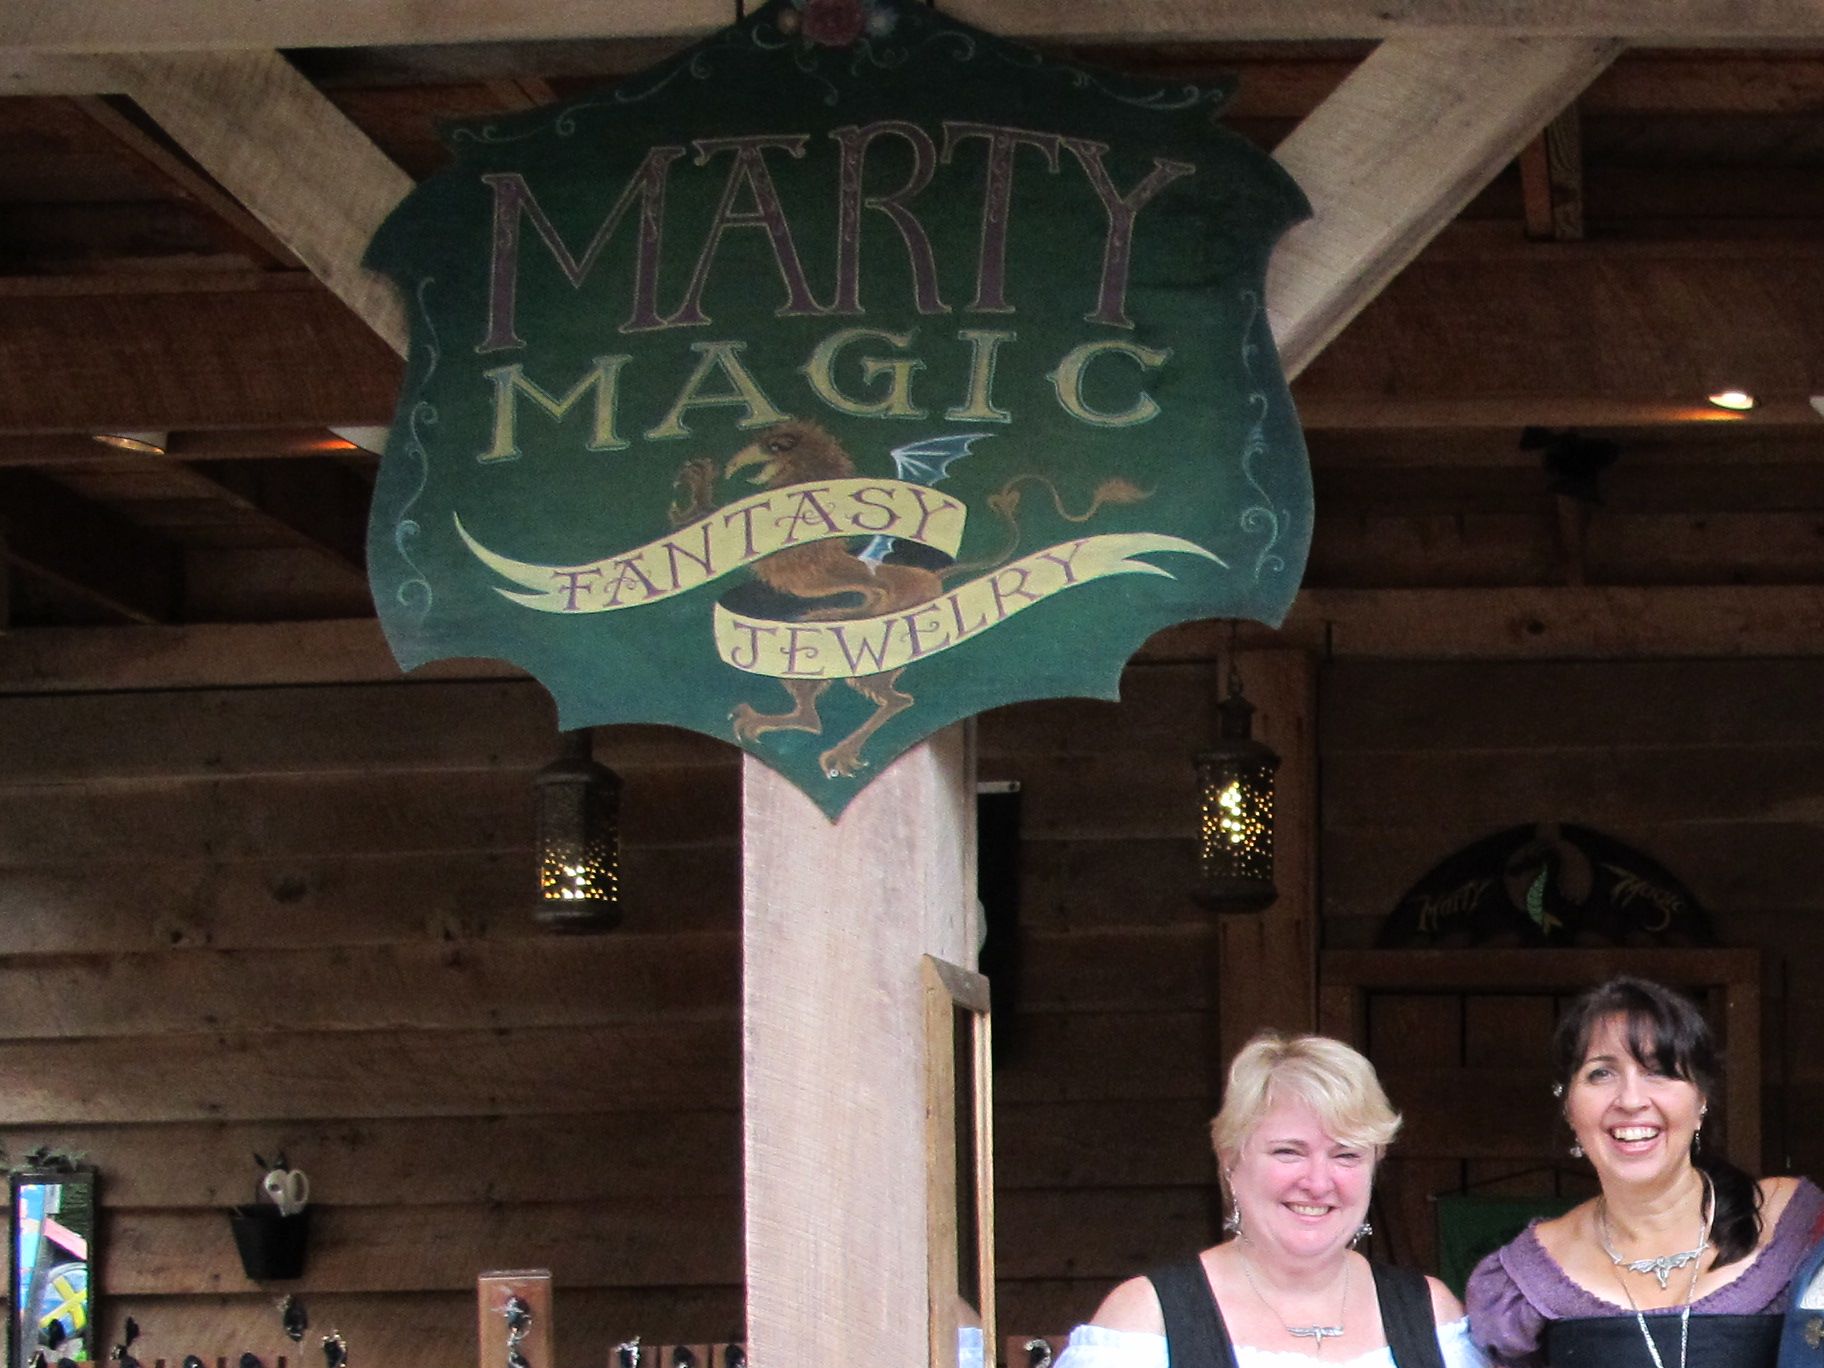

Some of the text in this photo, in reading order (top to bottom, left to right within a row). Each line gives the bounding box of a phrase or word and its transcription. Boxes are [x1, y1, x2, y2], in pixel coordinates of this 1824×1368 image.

[474, 120, 1196, 354] MARTY
[476, 327, 1175, 464] MAGIC
[552, 486, 958, 612] FANTASY
[730, 539, 1090, 676] JEWELRY
